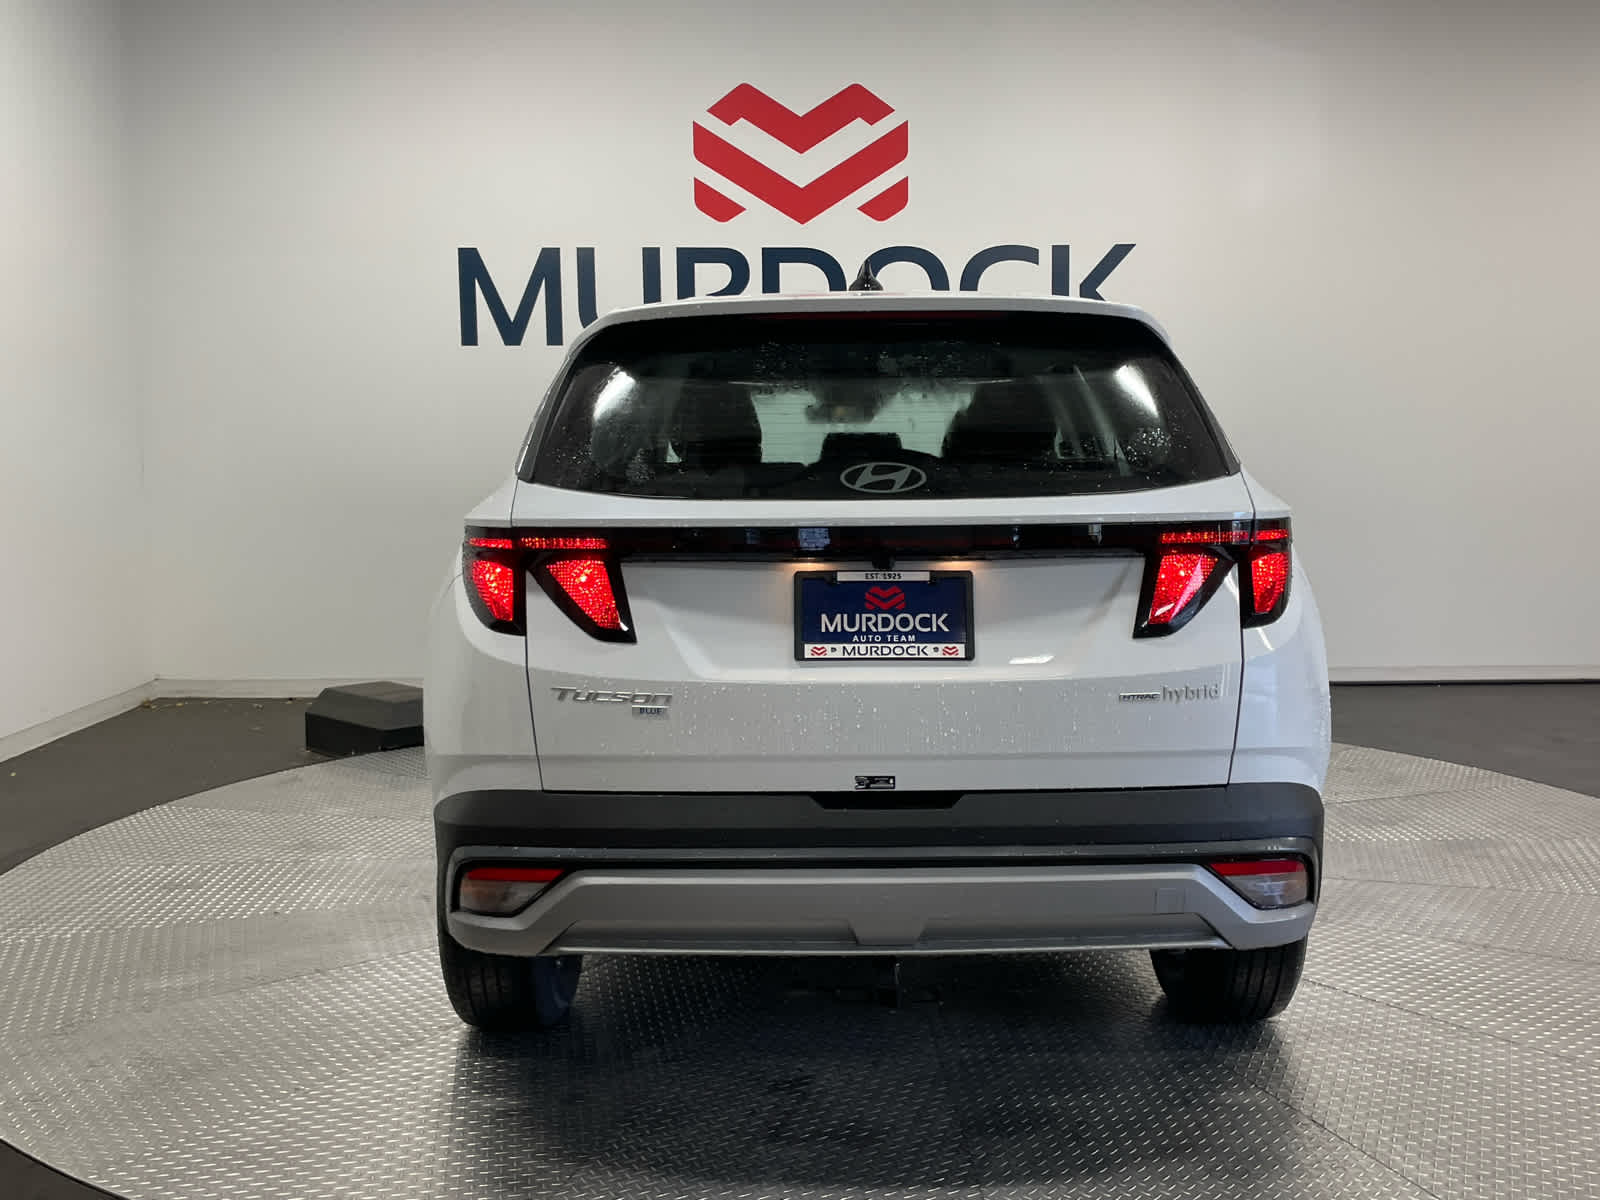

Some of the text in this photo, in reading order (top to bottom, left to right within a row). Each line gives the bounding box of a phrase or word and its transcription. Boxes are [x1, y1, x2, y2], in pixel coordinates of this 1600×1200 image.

[882, 572, 902, 580] 1925
[820, 613, 949, 633] MURDOCK
[852, 634, 916, 642] AUTO TEAM
[842, 645, 929, 657] MURDOCK
[1162, 683, 1220, 703] hybrid
